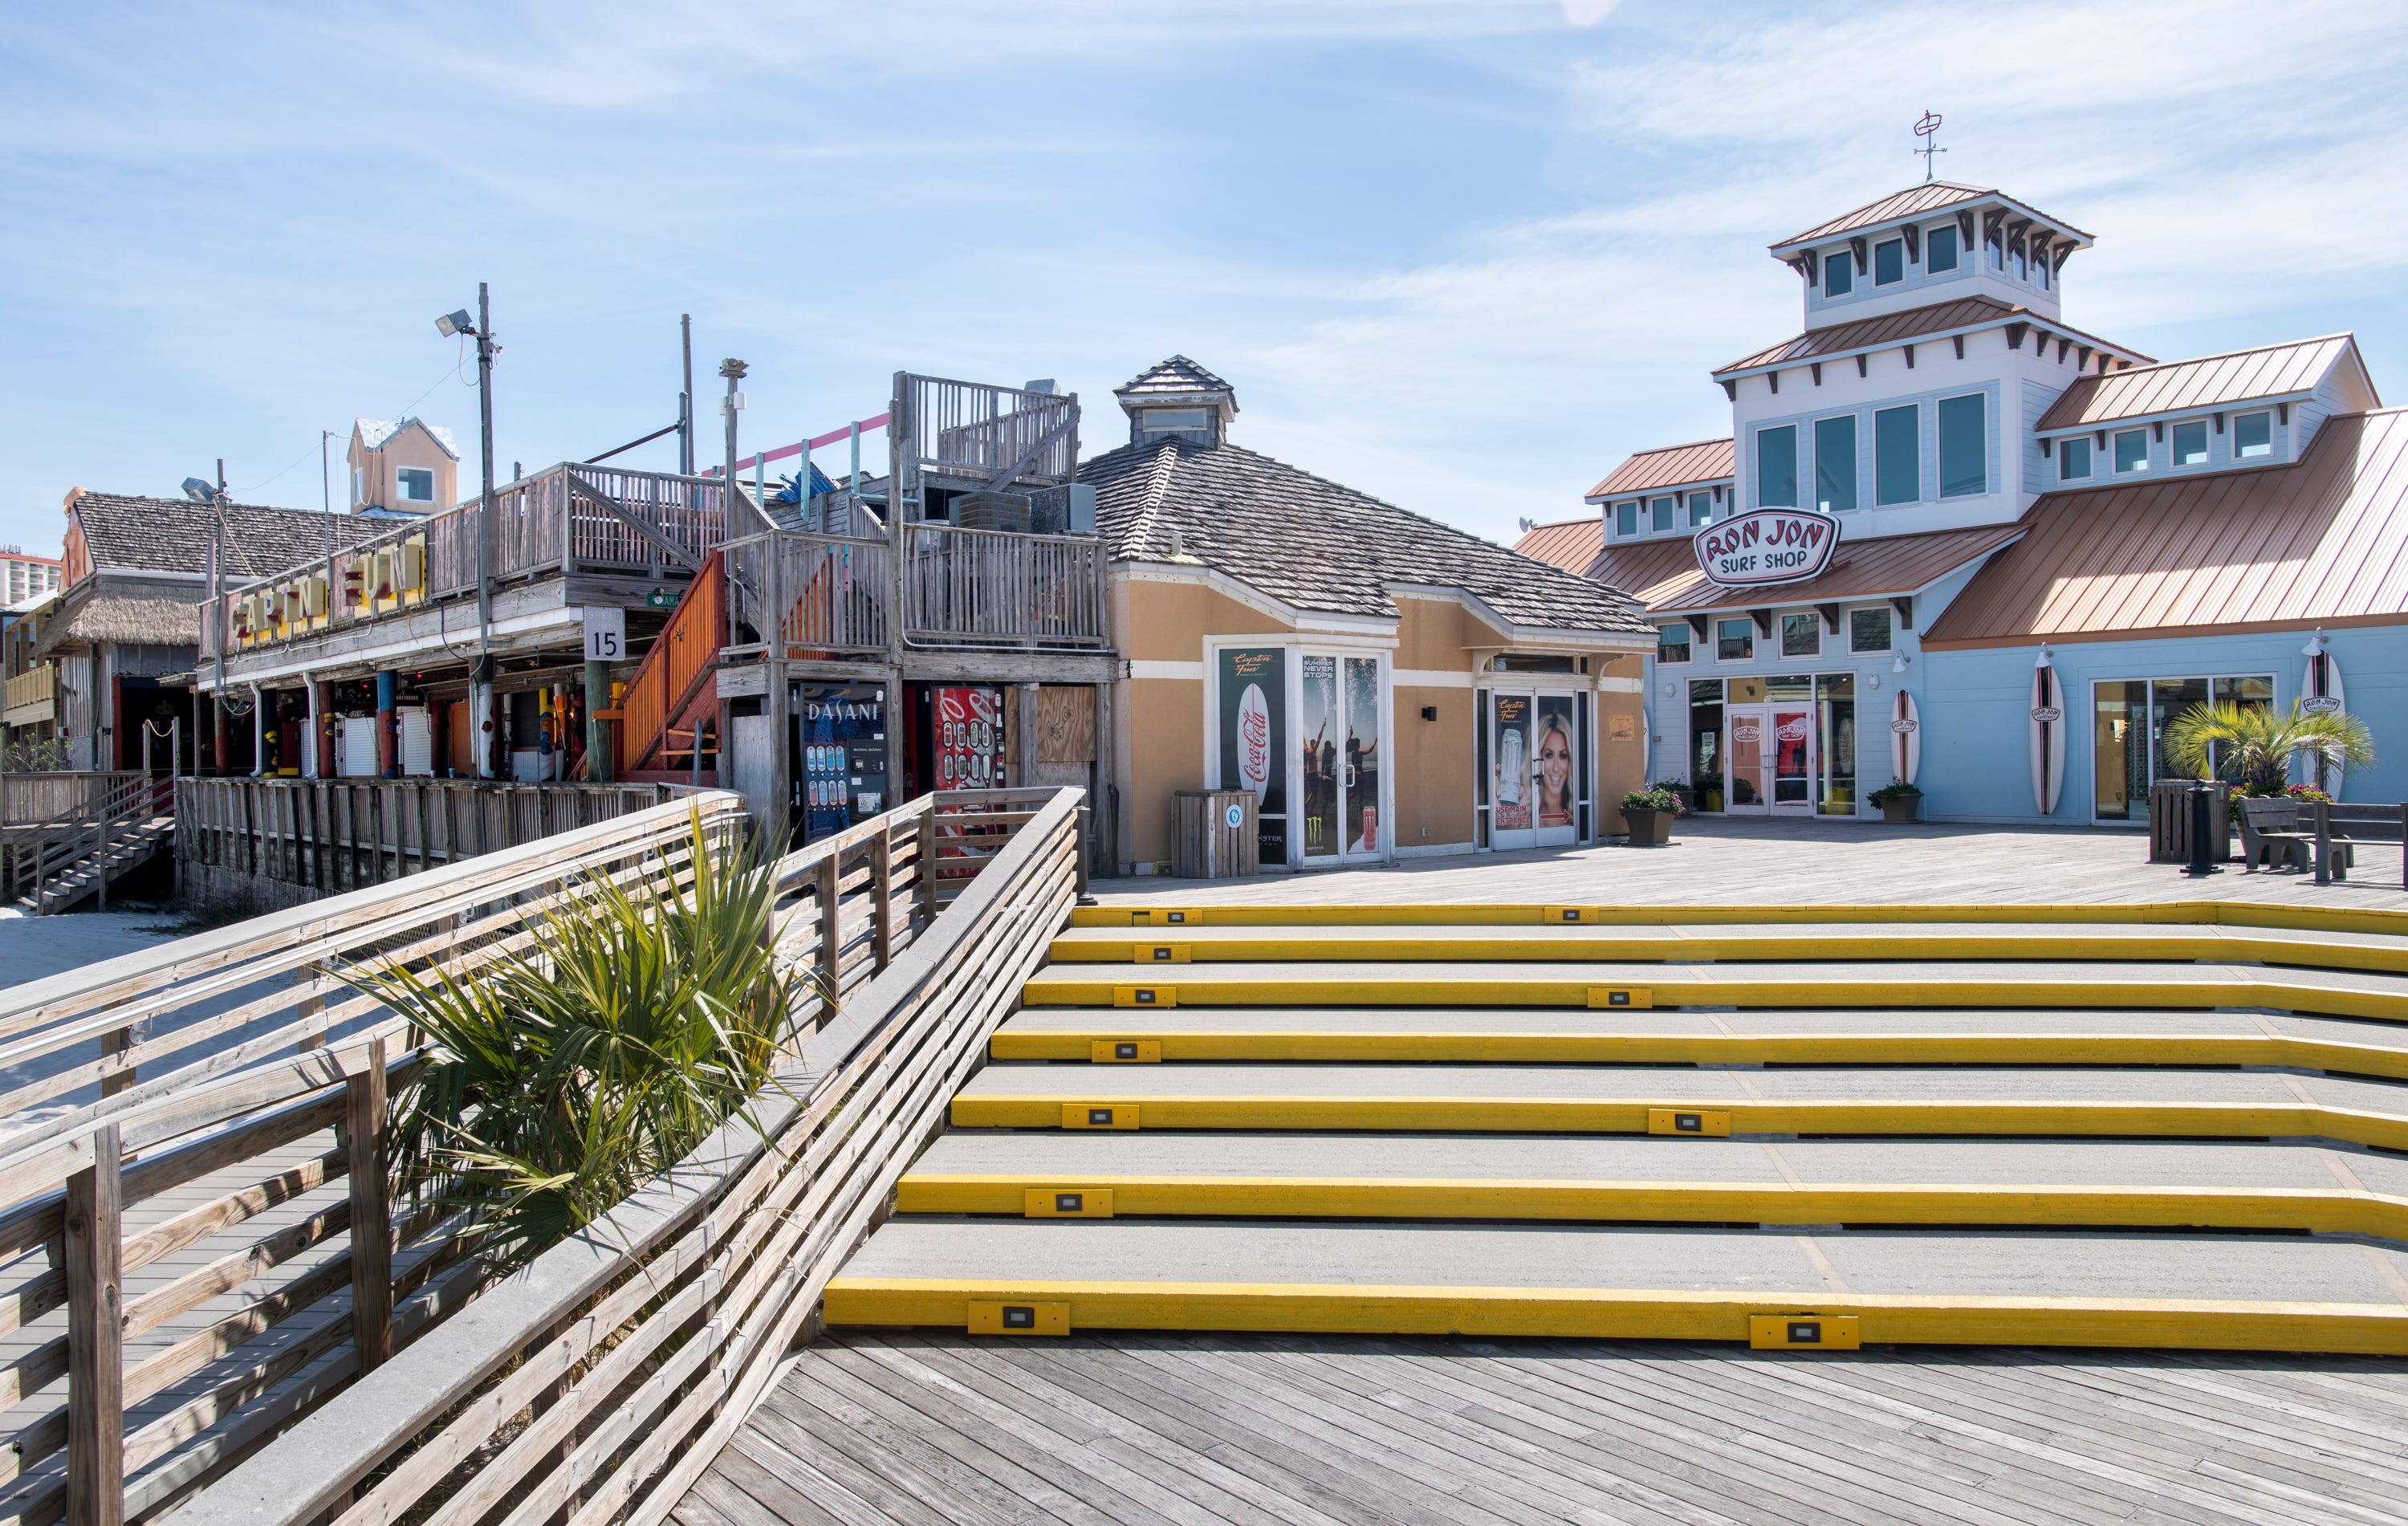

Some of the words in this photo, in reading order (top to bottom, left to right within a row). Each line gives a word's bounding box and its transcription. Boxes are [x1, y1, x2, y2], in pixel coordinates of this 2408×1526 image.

[1706, 520, 1759, 563] RON
[1765, 519, 1824, 549] JON
[1720, 555, 1757, 574] SURF
[1765, 551, 1807, 568] SHOP
[594, 632, 616, 656] 15
[1235, 664, 1261, 676] Fun
[808, 699, 877, 724] DASANI
[1500, 710, 1518, 723] Fun
[1243, 706, 1267, 783] Coca-Cola
[1496, 816, 1531, 824] ENTRANCE
